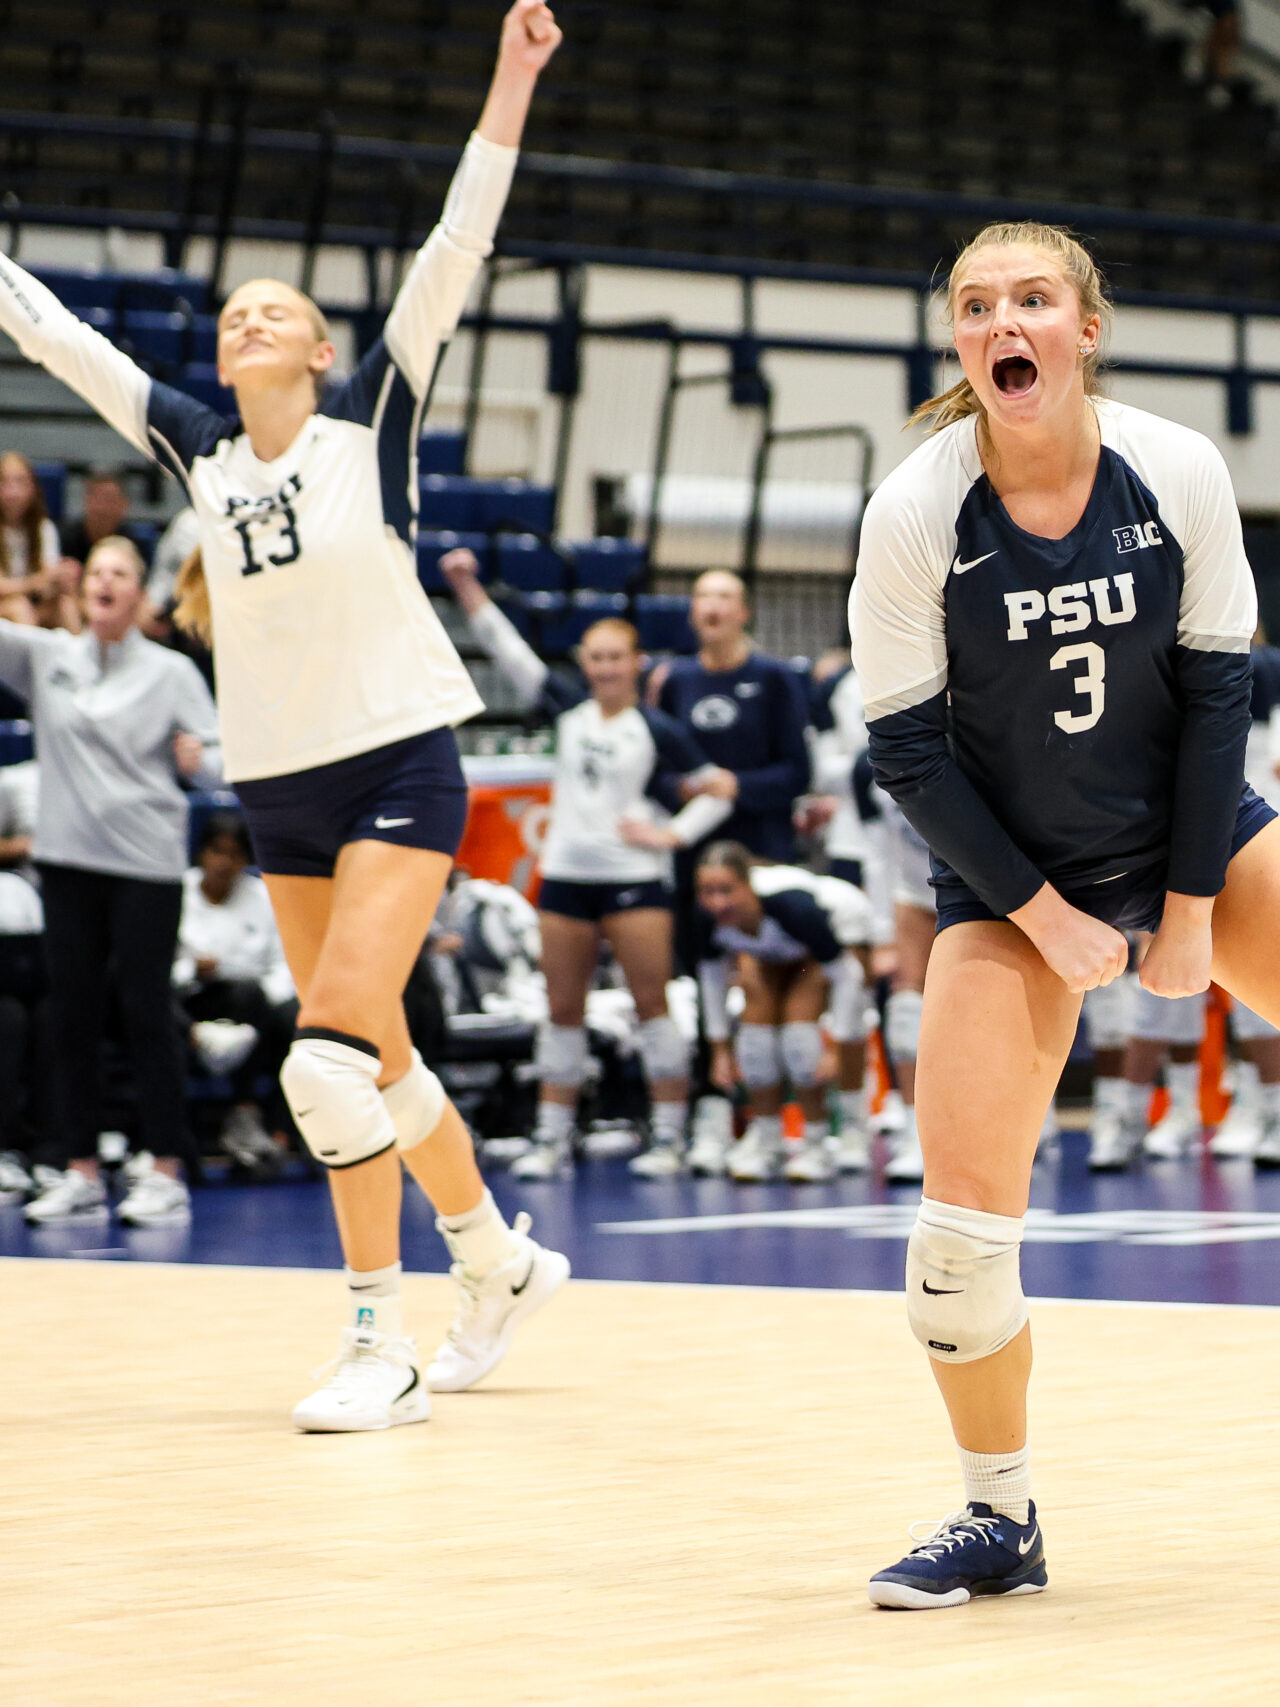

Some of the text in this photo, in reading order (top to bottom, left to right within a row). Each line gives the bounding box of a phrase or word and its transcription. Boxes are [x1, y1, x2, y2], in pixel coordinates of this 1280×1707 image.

[234, 505, 302, 577] 13
[1003, 572, 1137, 641] PSU
[1049, 641, 1105, 734] 3
